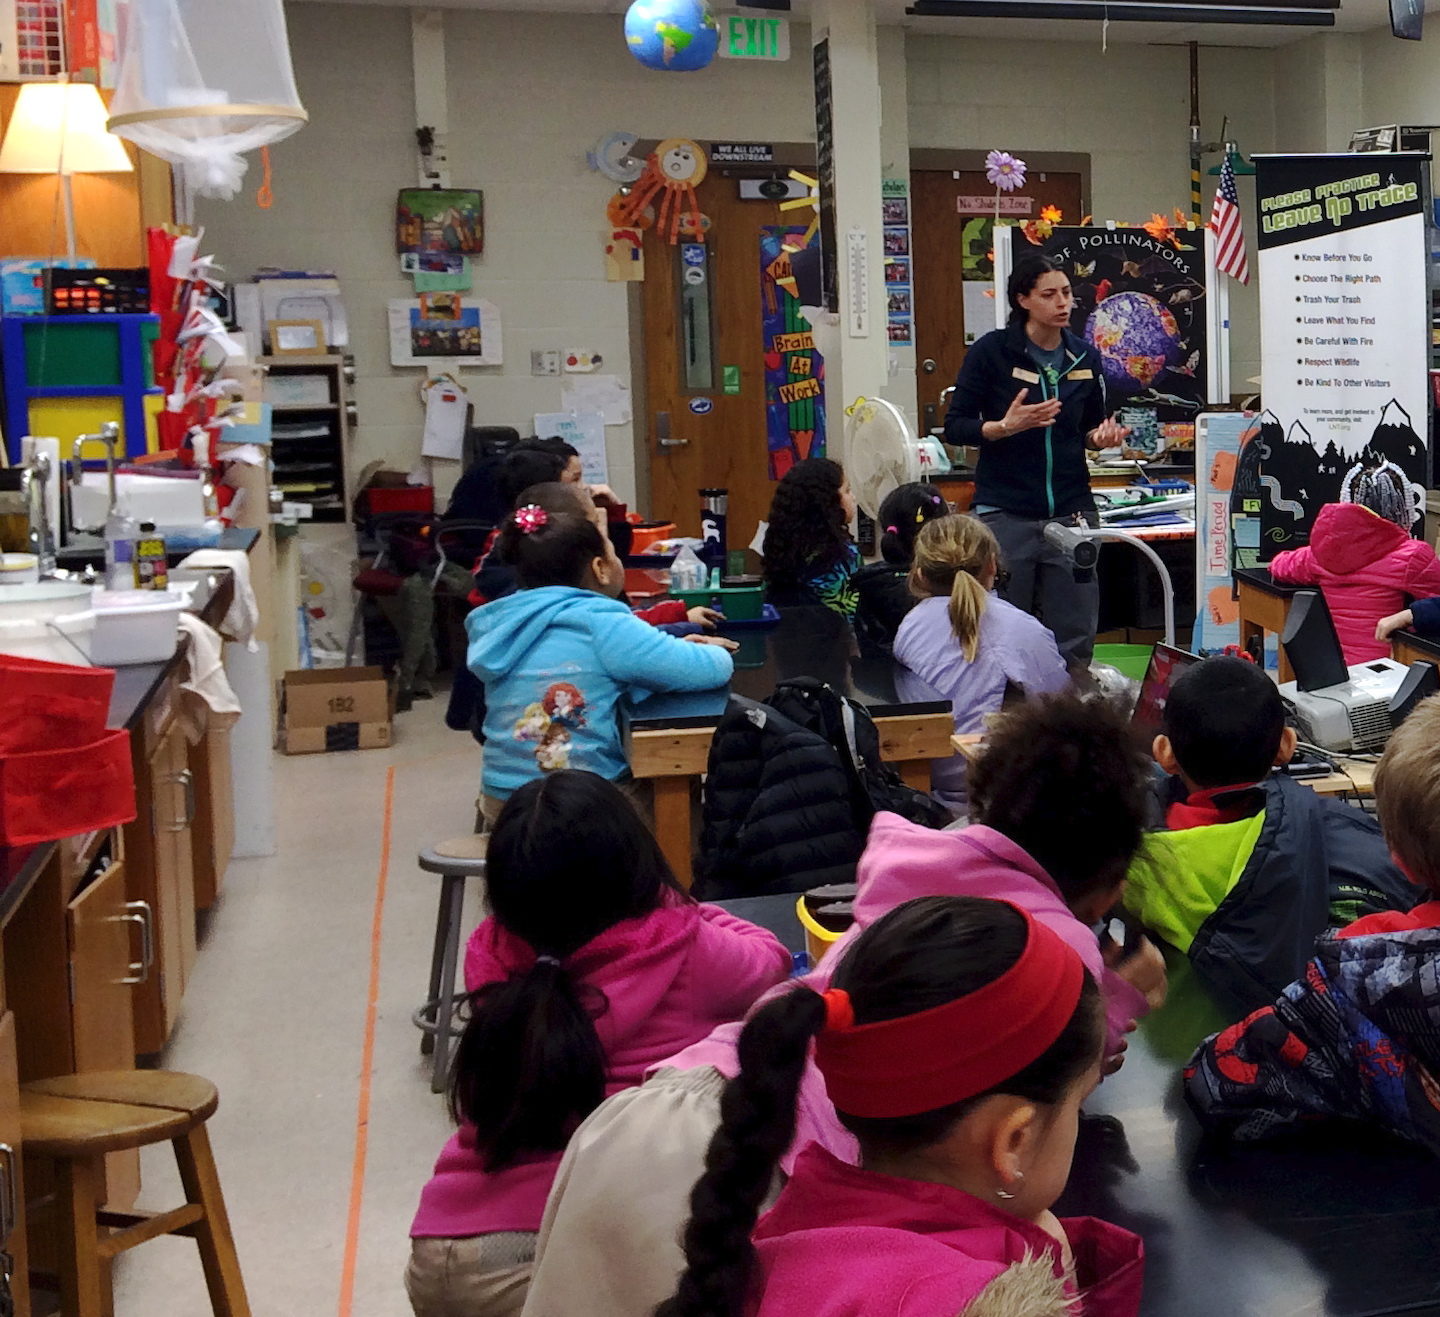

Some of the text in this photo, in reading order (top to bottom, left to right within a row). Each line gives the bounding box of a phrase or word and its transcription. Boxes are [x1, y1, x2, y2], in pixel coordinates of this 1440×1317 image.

[728, 17, 782, 58] EXIT
[1079, 233, 1191, 274] POLLINATORS
[1301, 253, 1373, 262] Know Before You Go
[1302, 274, 1381, 284] Choose The Right Path
[1303, 295, 1361, 304] Trash Your Trash
[1303, 316, 1376, 325] Leave What You Find
[775, 334, 813, 351] Brain
[1304, 337, 1373, 345] Be Careful With Fire
[792, 358, 808, 374] At
[1304, 357, 1360, 367] Respect Wildlife
[1304, 378, 1391, 388] Be Kind To Other Visitors
[781, 382, 819, 400] Work
[1209, 501, 1228, 572] Time Period
